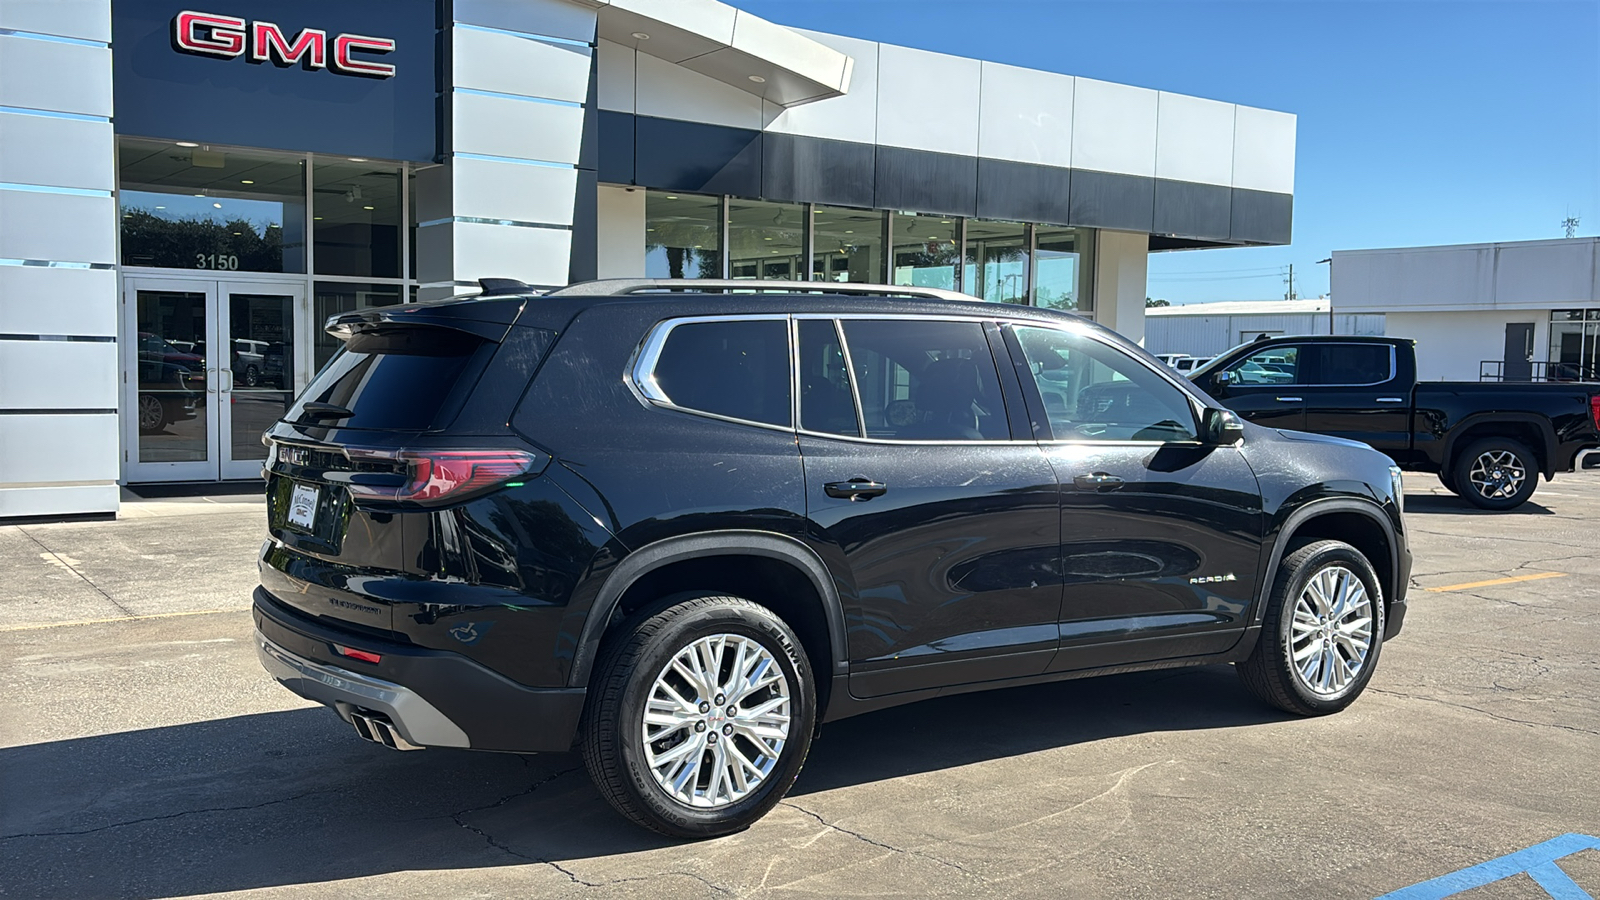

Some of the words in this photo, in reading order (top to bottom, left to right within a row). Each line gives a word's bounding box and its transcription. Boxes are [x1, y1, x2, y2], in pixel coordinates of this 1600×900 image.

[174, 10, 396, 78] GMC
[196, 253, 239, 270] 3150
[279, 447, 305, 466] GMC
[1189, 572, 1237, 585] ACADIA
